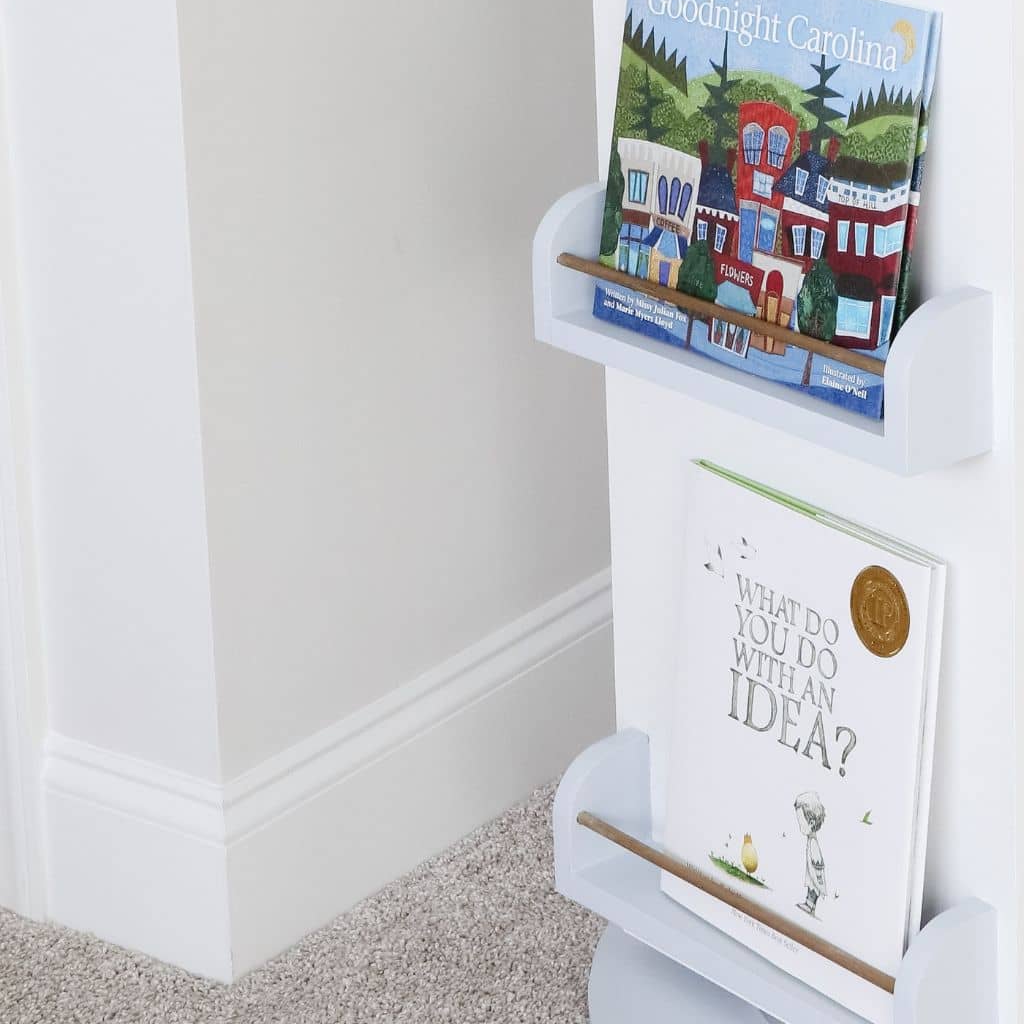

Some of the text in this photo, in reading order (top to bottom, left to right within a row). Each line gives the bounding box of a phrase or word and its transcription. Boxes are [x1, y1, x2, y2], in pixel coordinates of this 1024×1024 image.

[787, 15, 898, 72] Carolina
[655, 217, 681, 234] COFFEE
[720, 263, 754, 287] FLOWERS
[603, 298, 615, 309] and
[615, 301, 635, 316] Marie
[635, 309, 654, 323] Myers
[605, 287, 626, 302] Written
[627, 294, 634, 307] by
[653, 304, 674, 319] Julian
[822, 376, 867, 400] Elaine O'Neil
[823, 364, 866, 388] Illustrated by
[736, 573, 839, 645] WHAT DO
[735, 604, 838, 680] YOU DO
[733, 638, 836, 715] WITH AN
[728, 667, 857, 777] IDEA?
